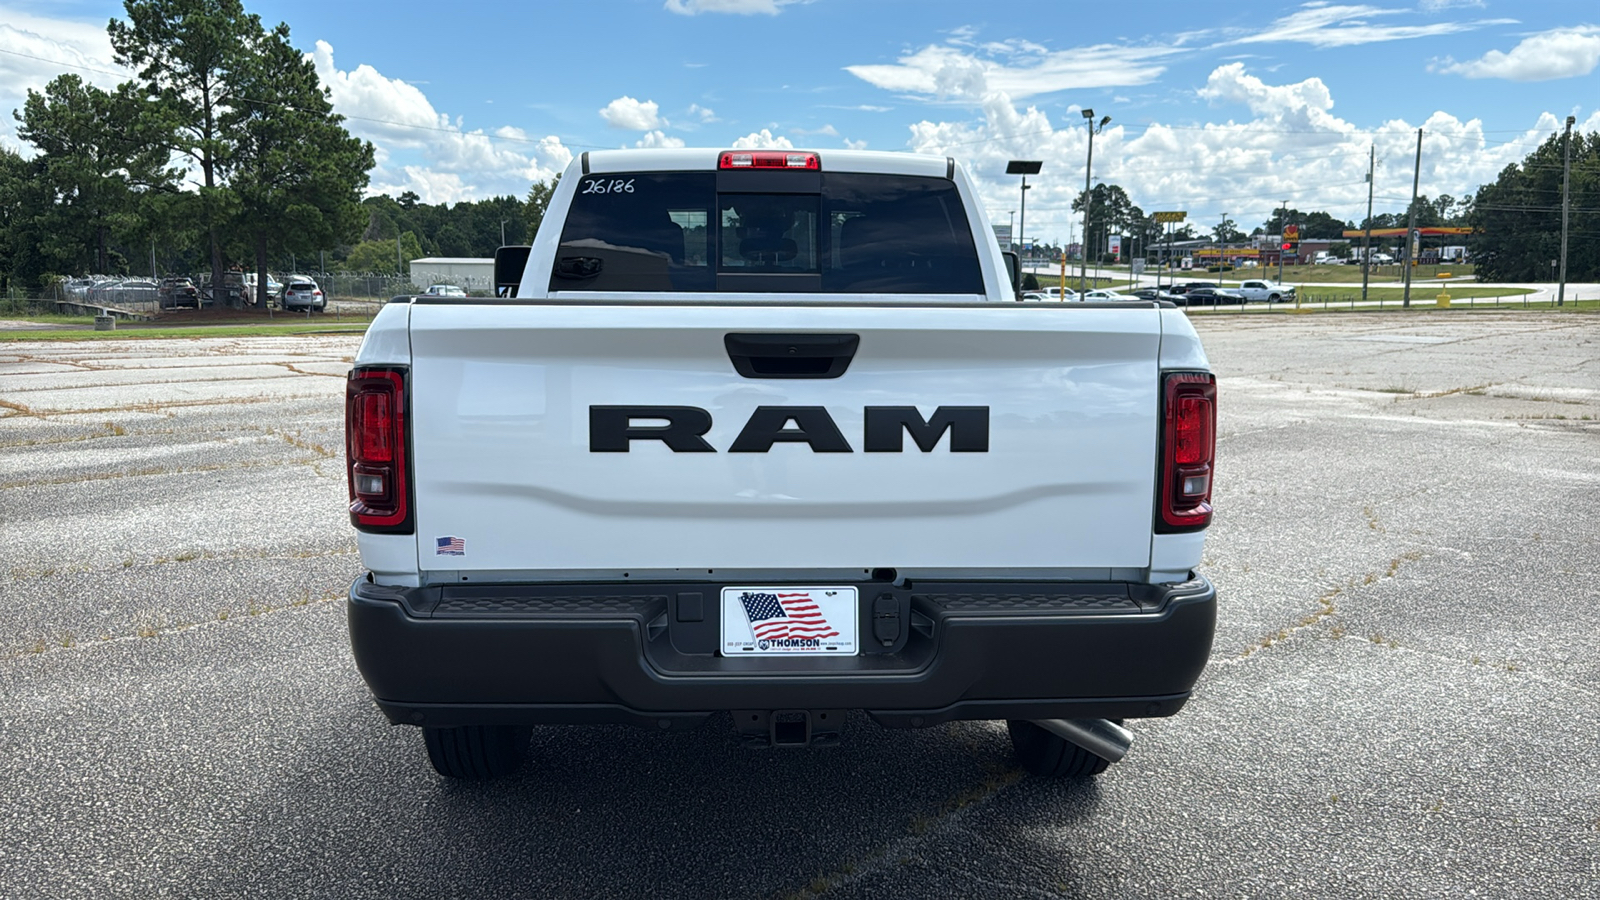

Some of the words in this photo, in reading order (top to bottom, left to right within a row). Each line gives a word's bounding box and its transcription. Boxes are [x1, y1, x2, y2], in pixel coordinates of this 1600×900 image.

[582, 178, 636, 194] 26186
[589, 405, 990, 453] RAM
[771, 639, 820, 647] THOMSON
